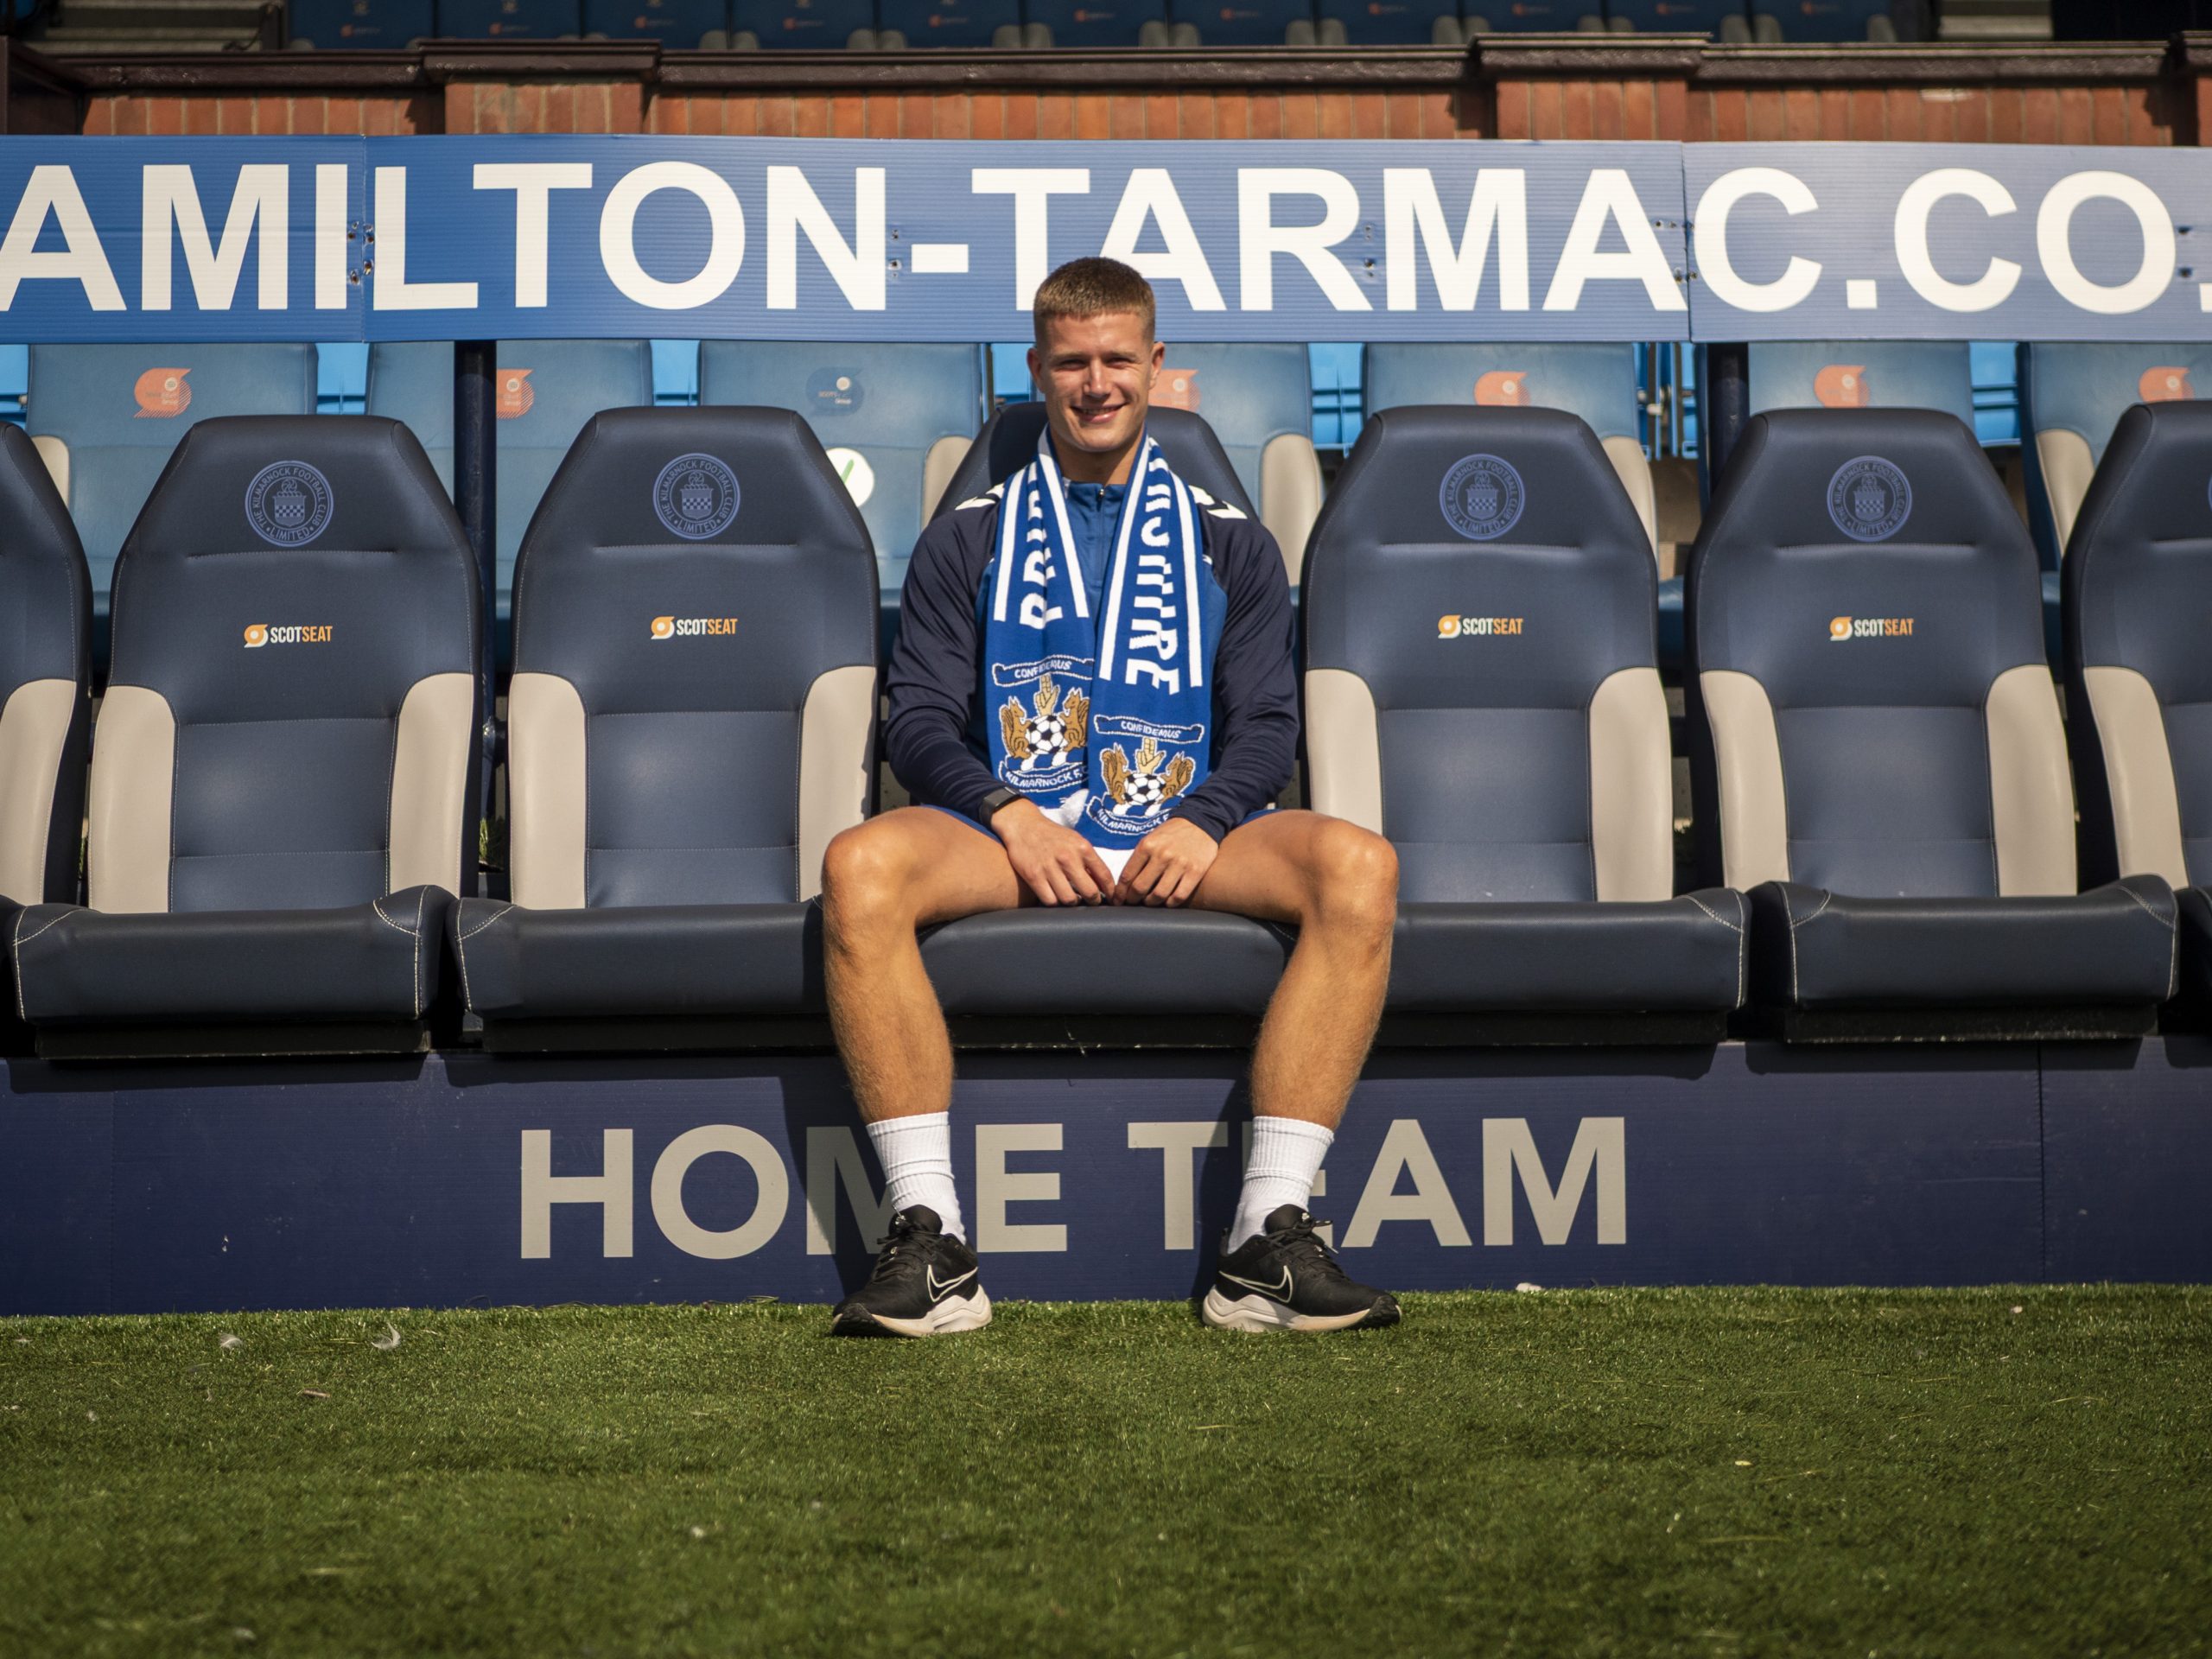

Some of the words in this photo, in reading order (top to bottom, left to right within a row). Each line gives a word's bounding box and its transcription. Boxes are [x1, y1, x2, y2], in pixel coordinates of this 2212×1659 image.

[252, 467, 290, 507] KILMARNOCK
[293, 467, 327, 502] FOOTBALL
[662, 461, 696, 501] KILMARNOCK
[699, 461, 734, 496] FOOTBALL
[1446, 461, 1484, 500] KILMARNOCK
[1487, 461, 1518, 495] FOOTBALL
[314, 502, 327, 528] CLUB
[662, 502, 674, 523] THE
[721, 497, 734, 520] CLUB
[1446, 502, 1459, 522] THE
[1505, 496, 1518, 520] CLUB
[252, 509, 267, 529] THE
[677, 520, 716, 534] LIMITED
[1461, 520, 1501, 534] LIMITED
[1851, 522, 1890, 536] LIMITED
[269, 527, 309, 541] LIMITED
[270, 625, 334, 644] SCOTSEAT
[676, 617, 739, 636] SCOTSEAT
[1462, 617, 1524, 635] SCOTSEAT
[1853, 618, 1915, 638] SCOTSEAT
[1014, 660, 1073, 679] CONFIDEMUS
[1121, 720, 1182, 739] CONFIDEMUS
[1005, 771, 1073, 788] KILMARNOCK
[1097, 808, 1162, 832] KILMARNOCK
[1127, 1116, 1627, 1250] TAM
